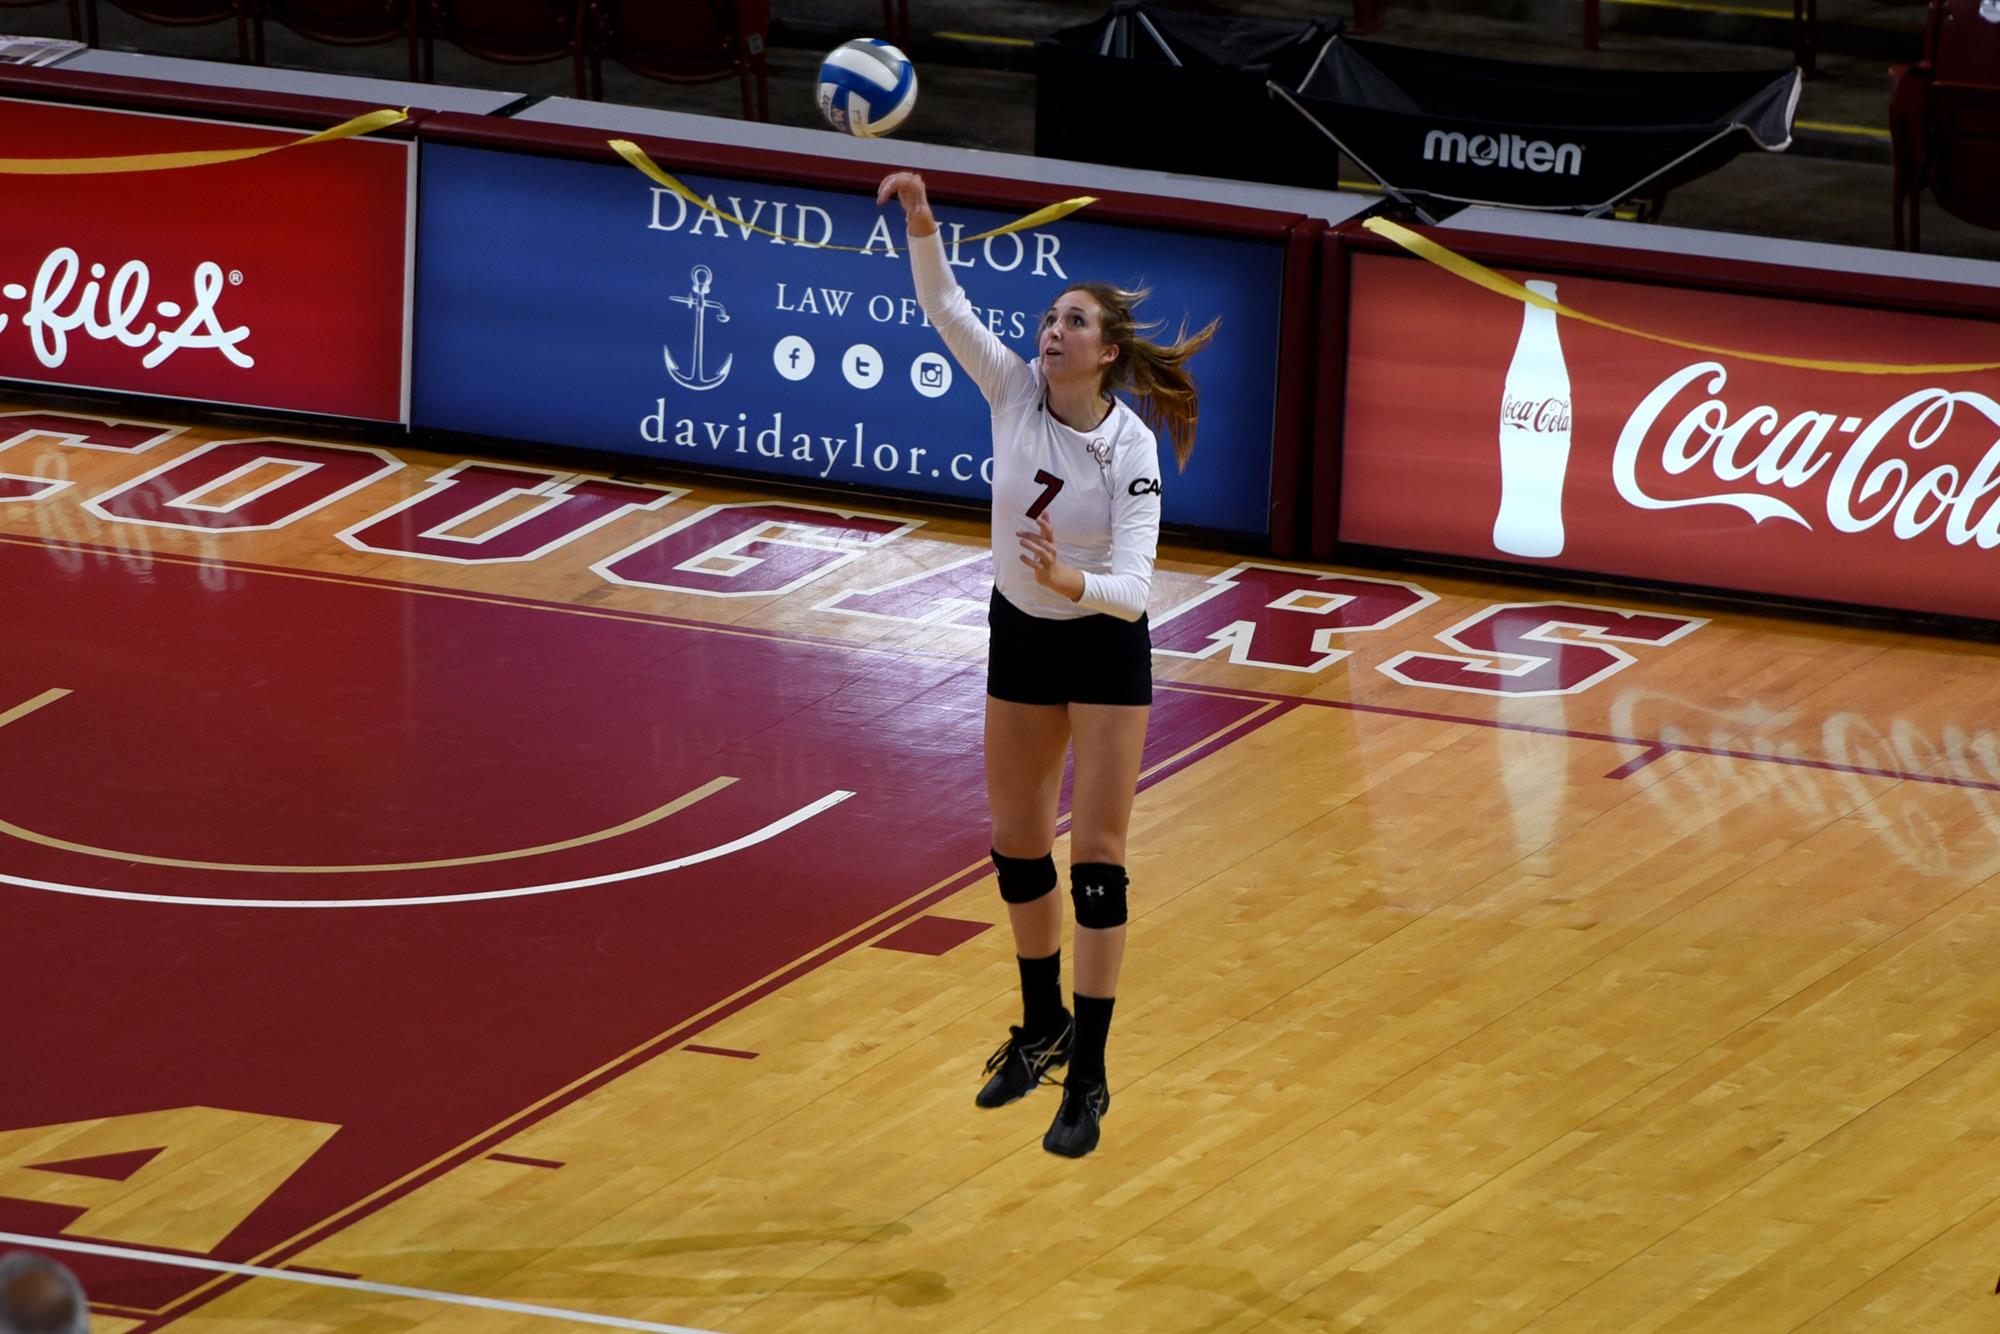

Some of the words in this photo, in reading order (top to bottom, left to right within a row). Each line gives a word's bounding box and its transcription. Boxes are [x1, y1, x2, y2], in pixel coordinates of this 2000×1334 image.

[1423, 129, 1583, 176] molten
[648, 186, 834, 248] DAVID
[860, 214, 1069, 280] ALOR
[776, 282, 854, 317] LAW
[868, 294, 1026, 339] OFES
[1502, 393, 1571, 434] Coca-Cola
[1025, 468, 1065, 521] 7
[1128, 477, 1162, 497] CA
